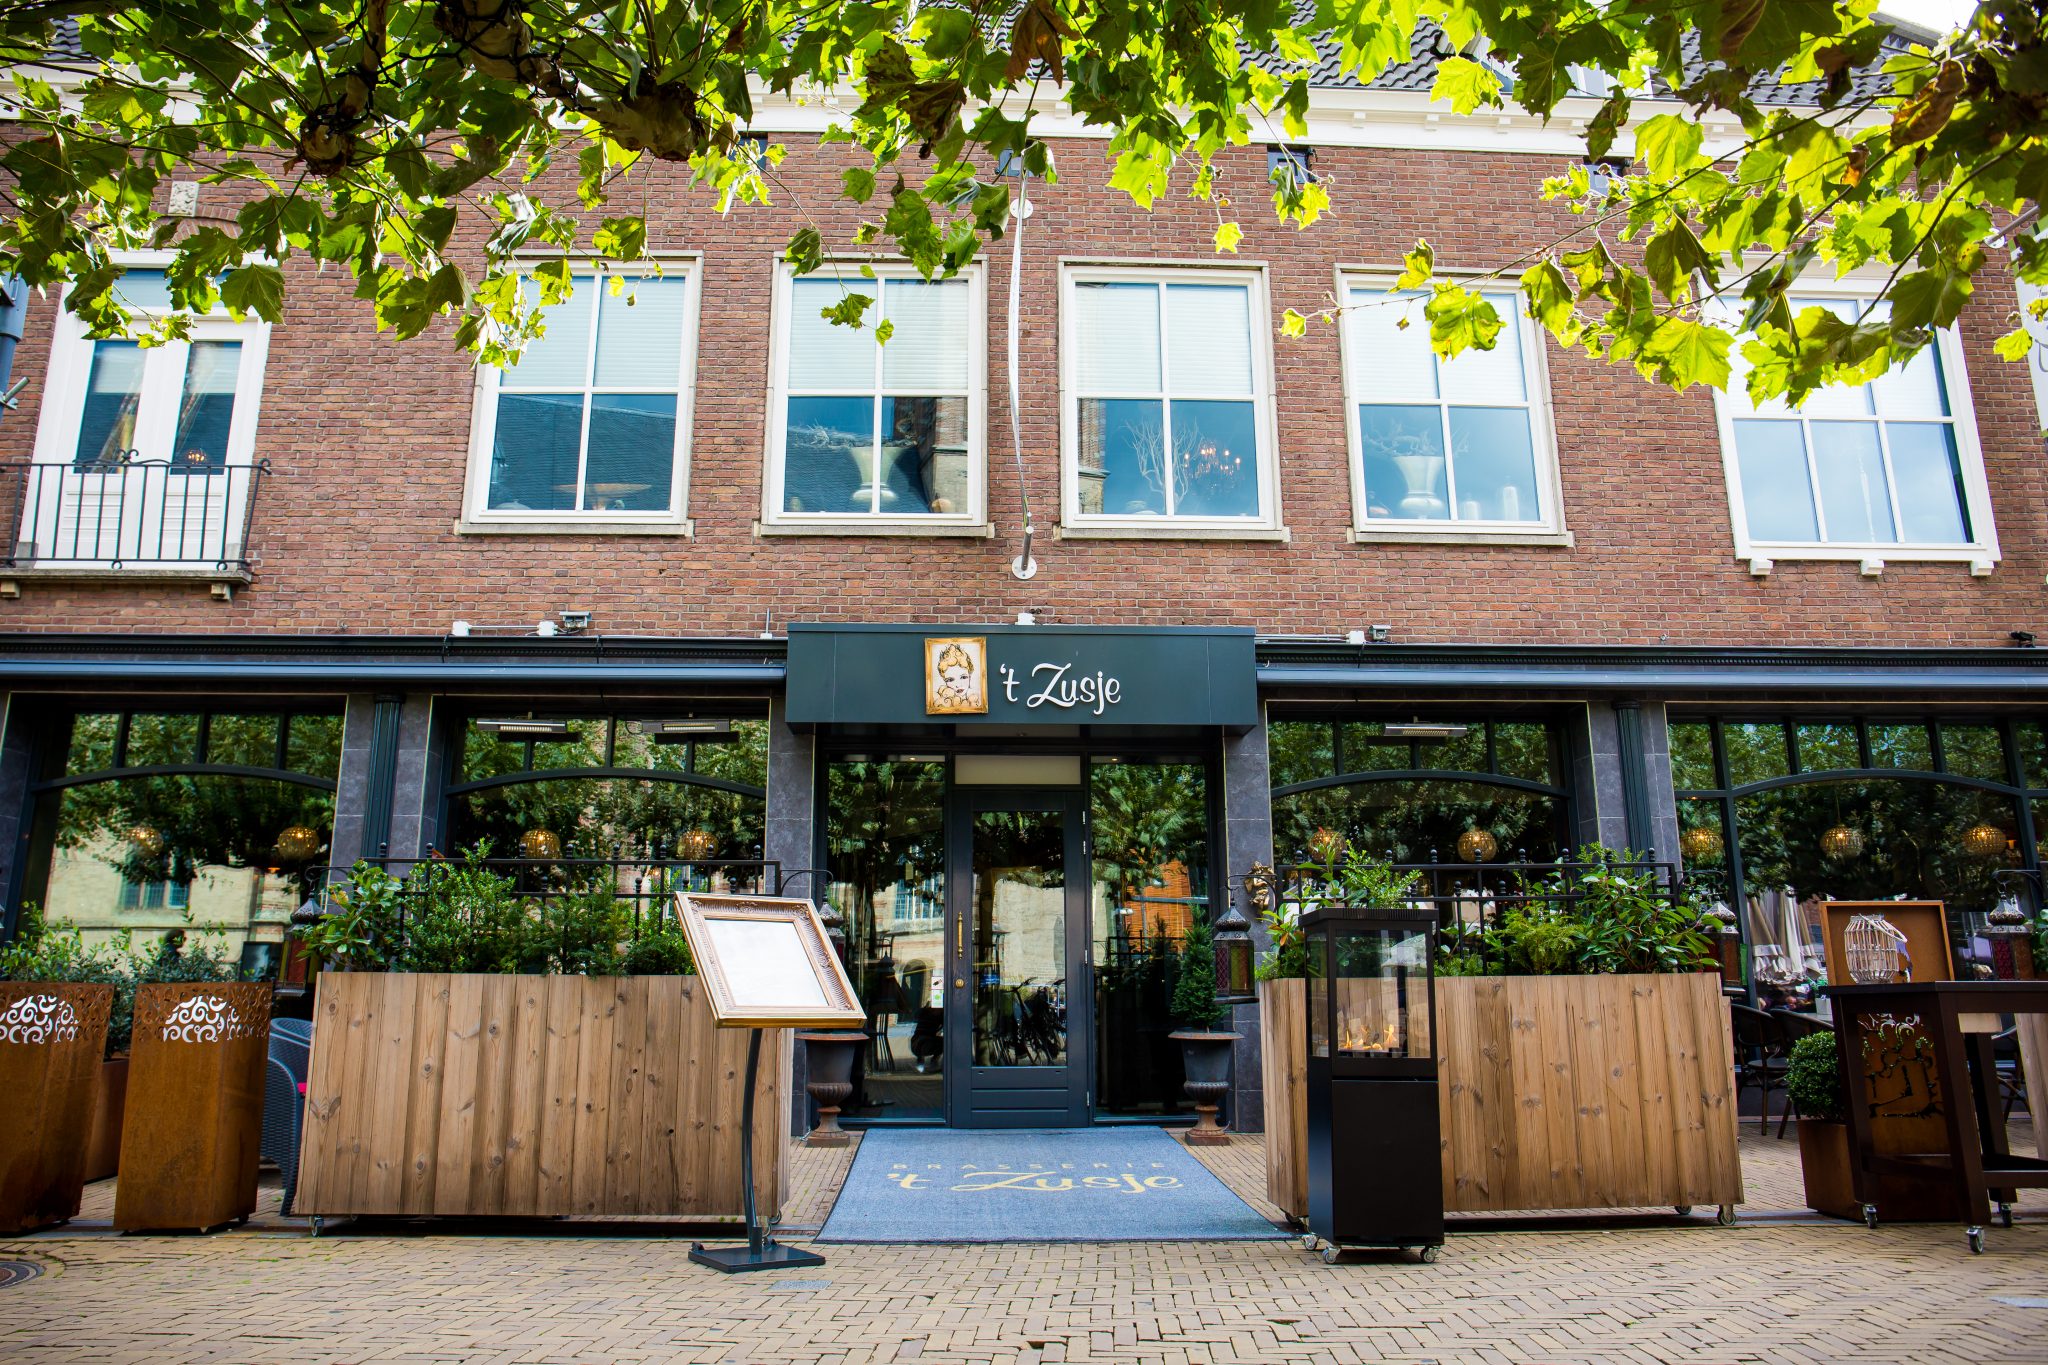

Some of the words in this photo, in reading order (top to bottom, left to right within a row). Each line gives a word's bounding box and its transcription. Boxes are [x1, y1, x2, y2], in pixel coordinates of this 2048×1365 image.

[1026, 662, 1121, 715] Zusje
[893, 1162, 1165, 1171] BRASSERIE
[950, 1171, 1185, 1194] Zusje
